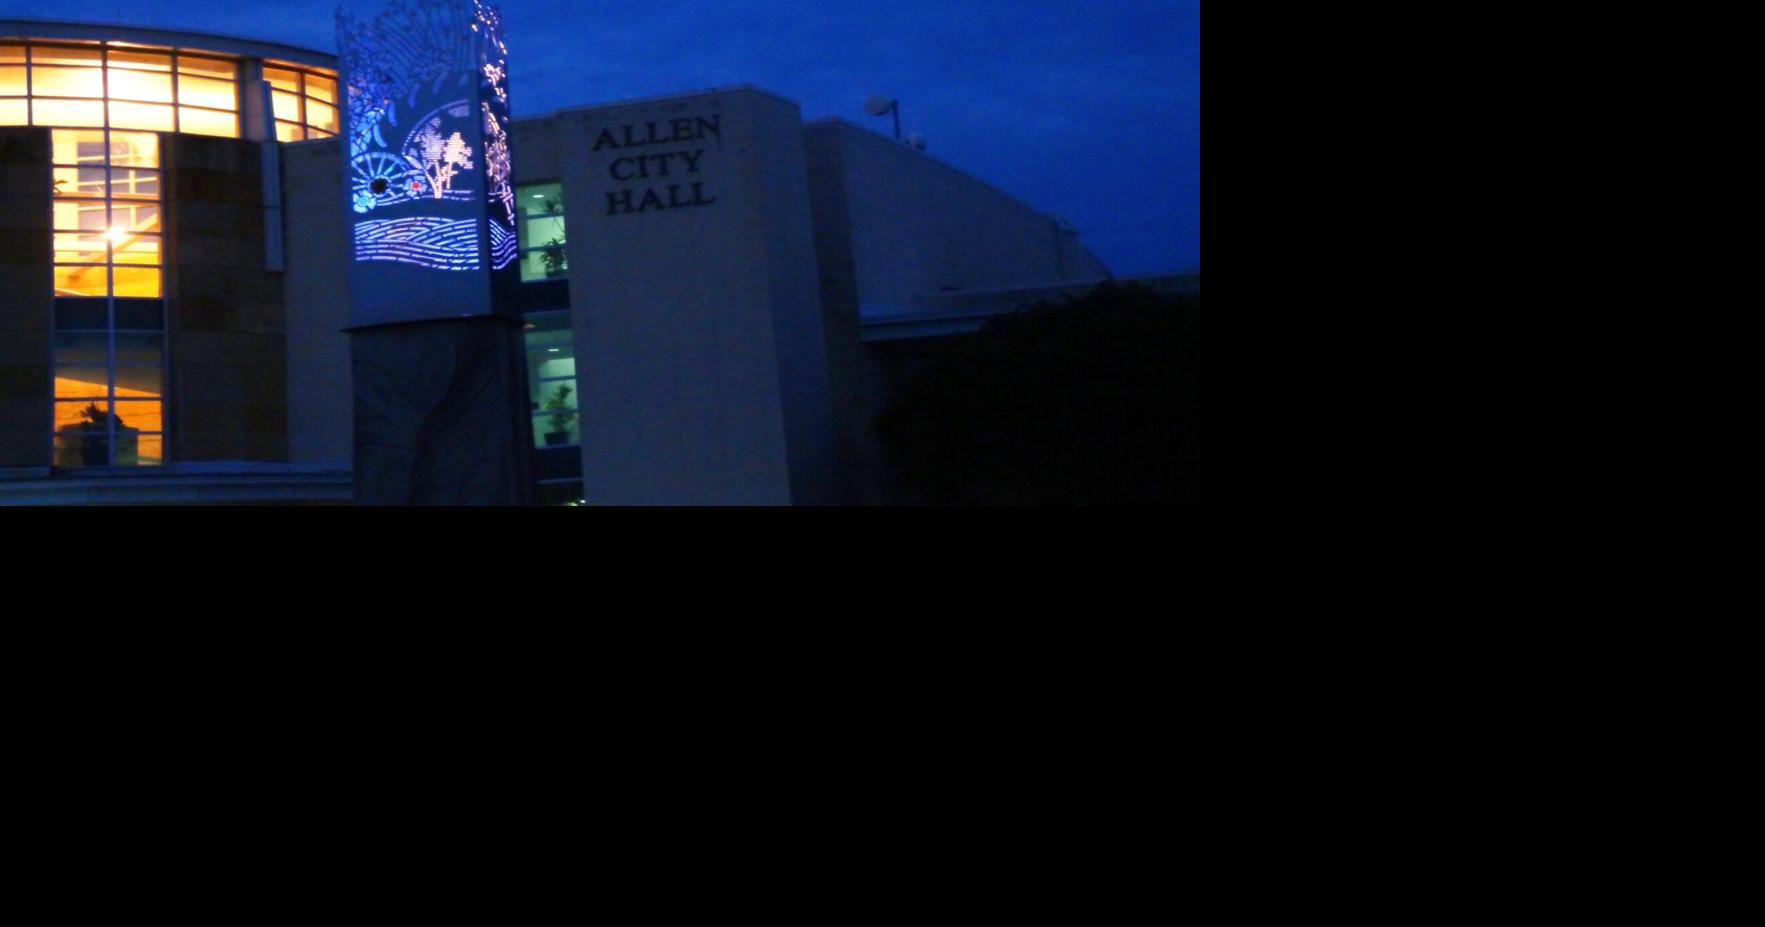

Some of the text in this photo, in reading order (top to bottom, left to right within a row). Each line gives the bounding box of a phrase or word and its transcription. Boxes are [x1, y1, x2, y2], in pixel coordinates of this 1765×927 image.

[592, 114, 721, 151] ALLEN
[610, 149, 704, 180] CITY
[605, 182, 717, 215] HALL
